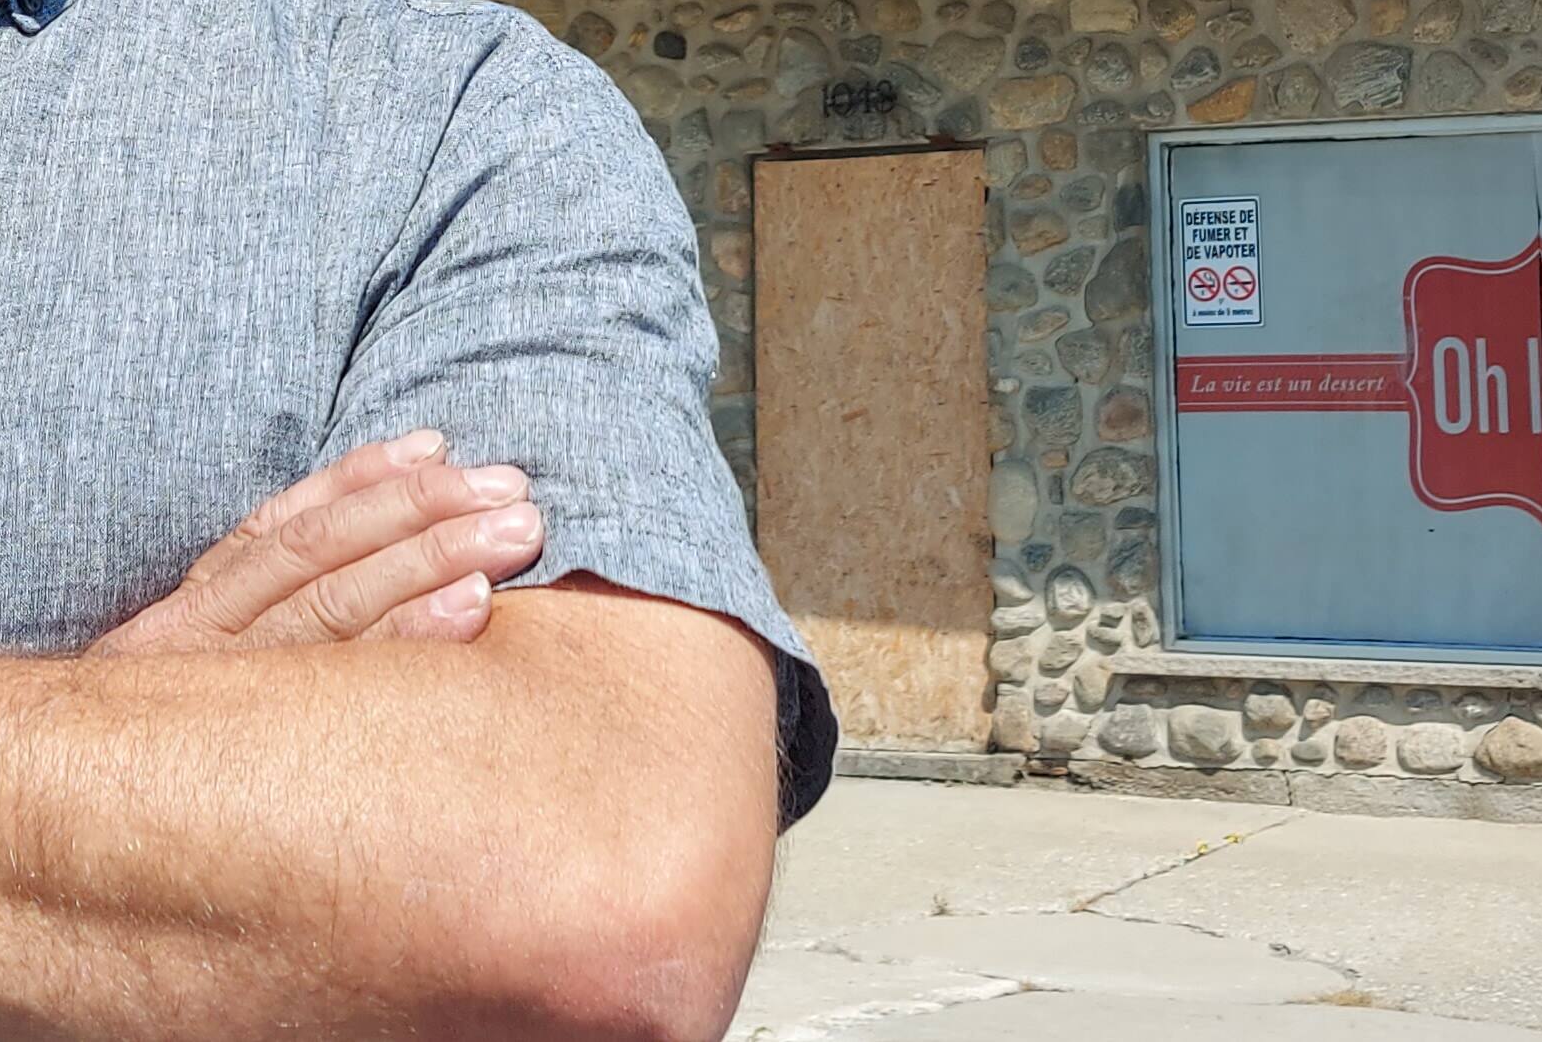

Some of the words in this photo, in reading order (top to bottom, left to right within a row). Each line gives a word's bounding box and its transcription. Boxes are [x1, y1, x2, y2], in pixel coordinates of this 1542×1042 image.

[1186, 208, 1236, 226] DÉFENSE
[1239, 209, 1254, 224] DE
[1192, 227, 1231, 242] FUMER
[1234, 227, 1249, 241] ET
[1186, 246, 1201, 260] DE
[1204, 243, 1256, 259] VAPOTER
[1190, 374, 1216, 392] La
[1222, 375, 1251, 393] vie
[1256, 377, 1282, 392] est
[1288, 378, 1312, 392] un
[1318, 373, 1385, 392] dessert
[1433, 336, 1509, 435] Oh
